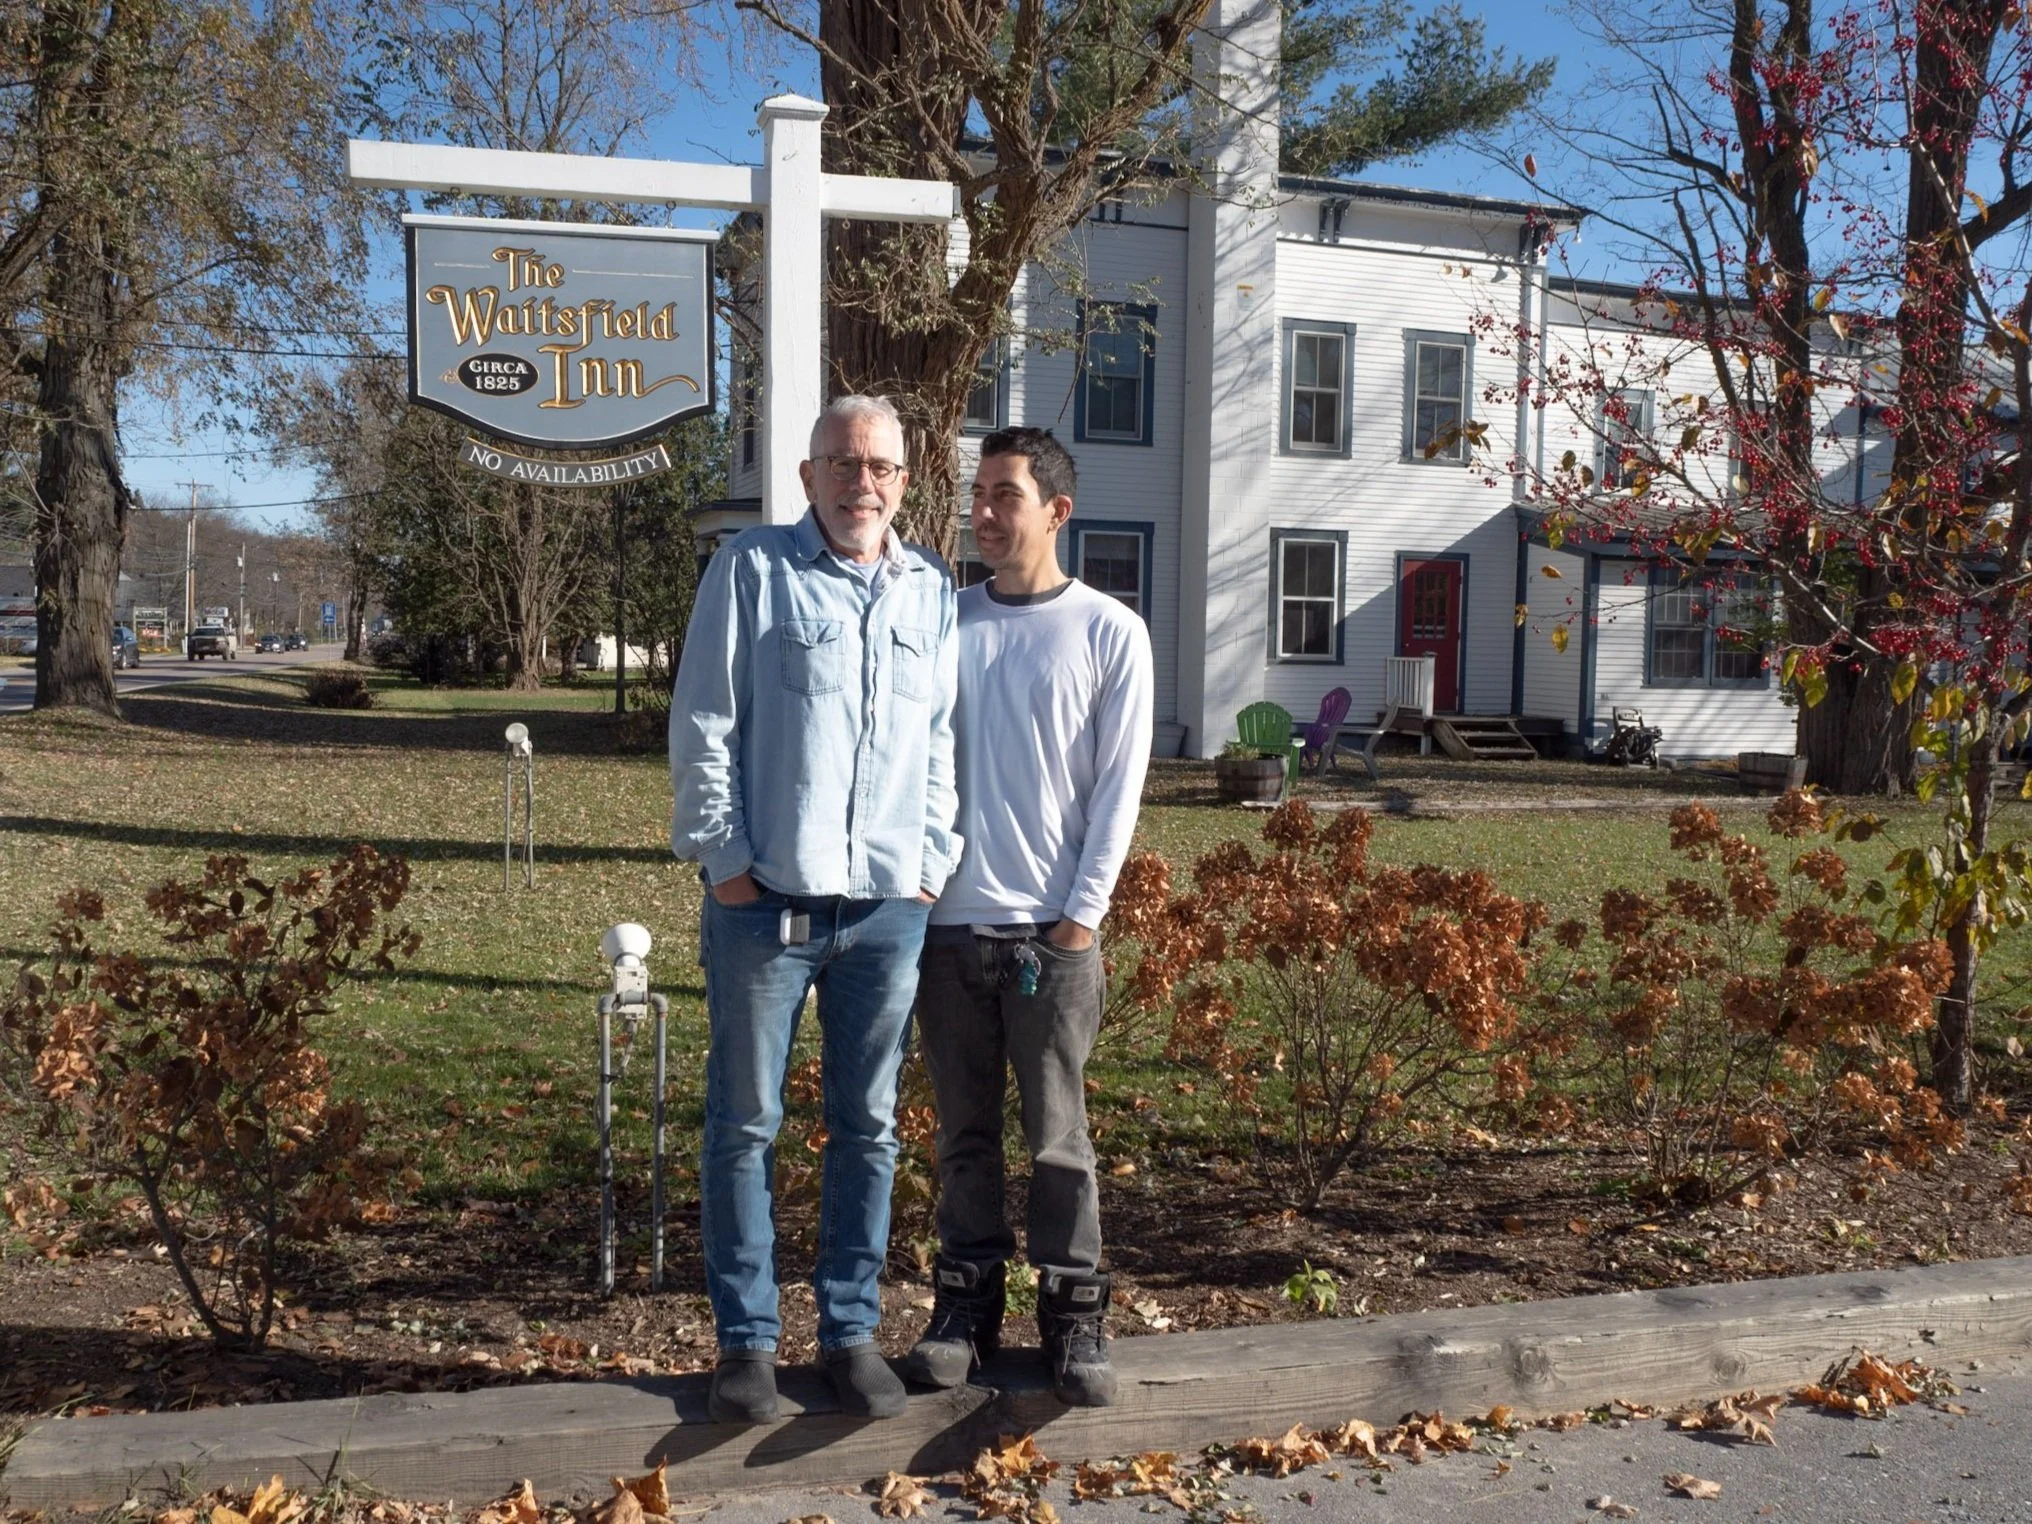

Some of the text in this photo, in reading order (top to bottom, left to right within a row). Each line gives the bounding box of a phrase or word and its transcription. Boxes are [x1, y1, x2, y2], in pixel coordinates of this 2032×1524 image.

[491, 246, 565, 292] The
[425, 285, 680, 347] Waitsfield
[475, 375, 521, 391] 1825
[536, 343, 699, 410] Inn
[468, 445, 659, 484] NO AVAILABILITY
